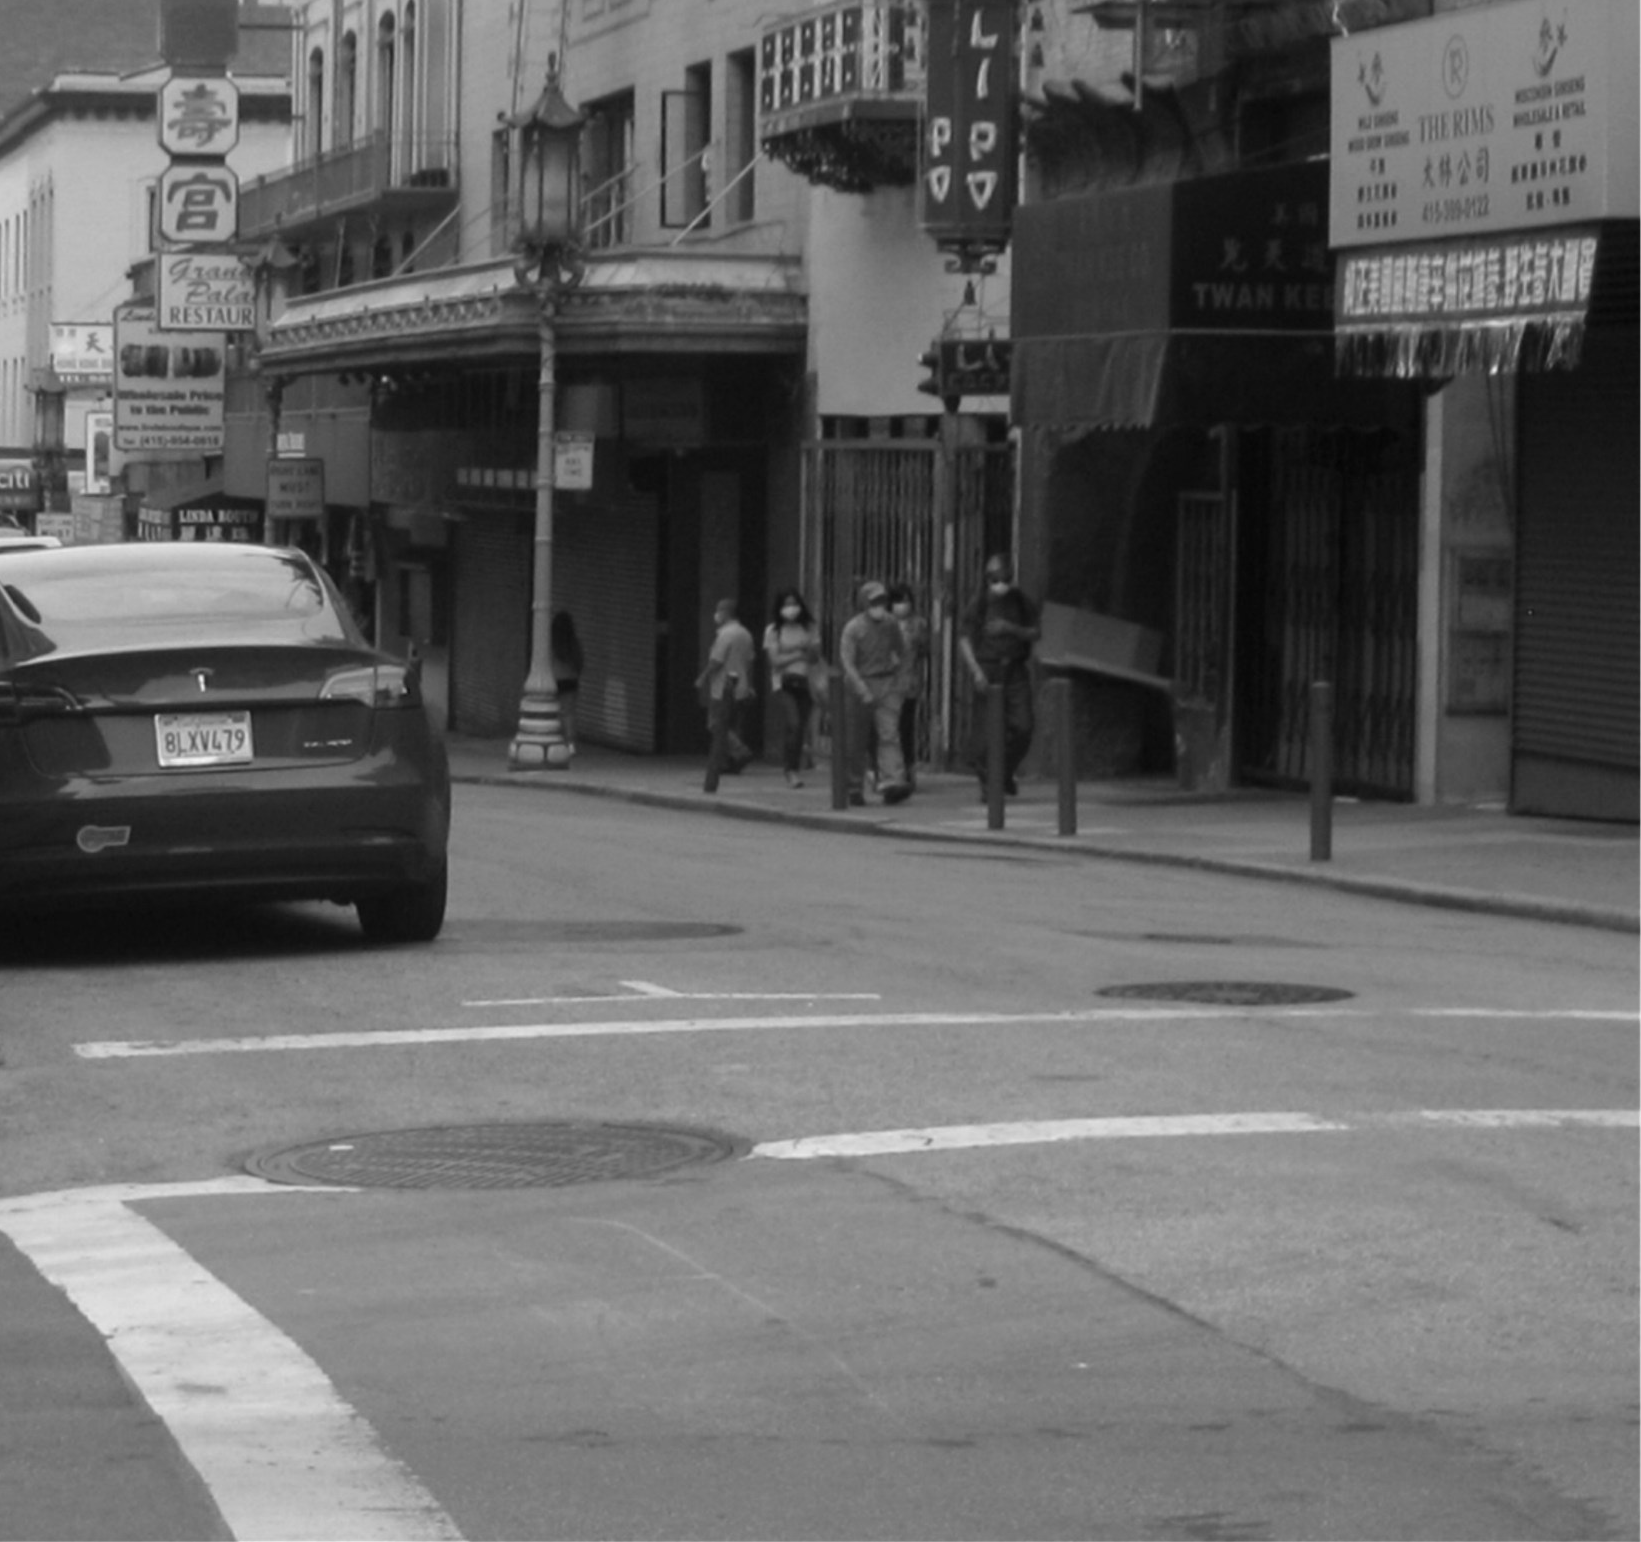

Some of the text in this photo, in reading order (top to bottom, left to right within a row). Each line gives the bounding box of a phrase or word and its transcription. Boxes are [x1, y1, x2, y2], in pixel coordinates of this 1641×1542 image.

[1417, 103, 1496, 144] THE RIMS
[185, 281, 252, 307] Pala
[1191, 281, 1275, 312] TWAN
[120, 307, 156, 323] Lind
[169, 305, 253, 326] RESTAUR
[116, 390, 224, 403] Wholesale Price
[169, 404, 211, 416] Public
[179, 509, 215, 524] LINDA
[164, 728, 247, 758] 8LXV479
